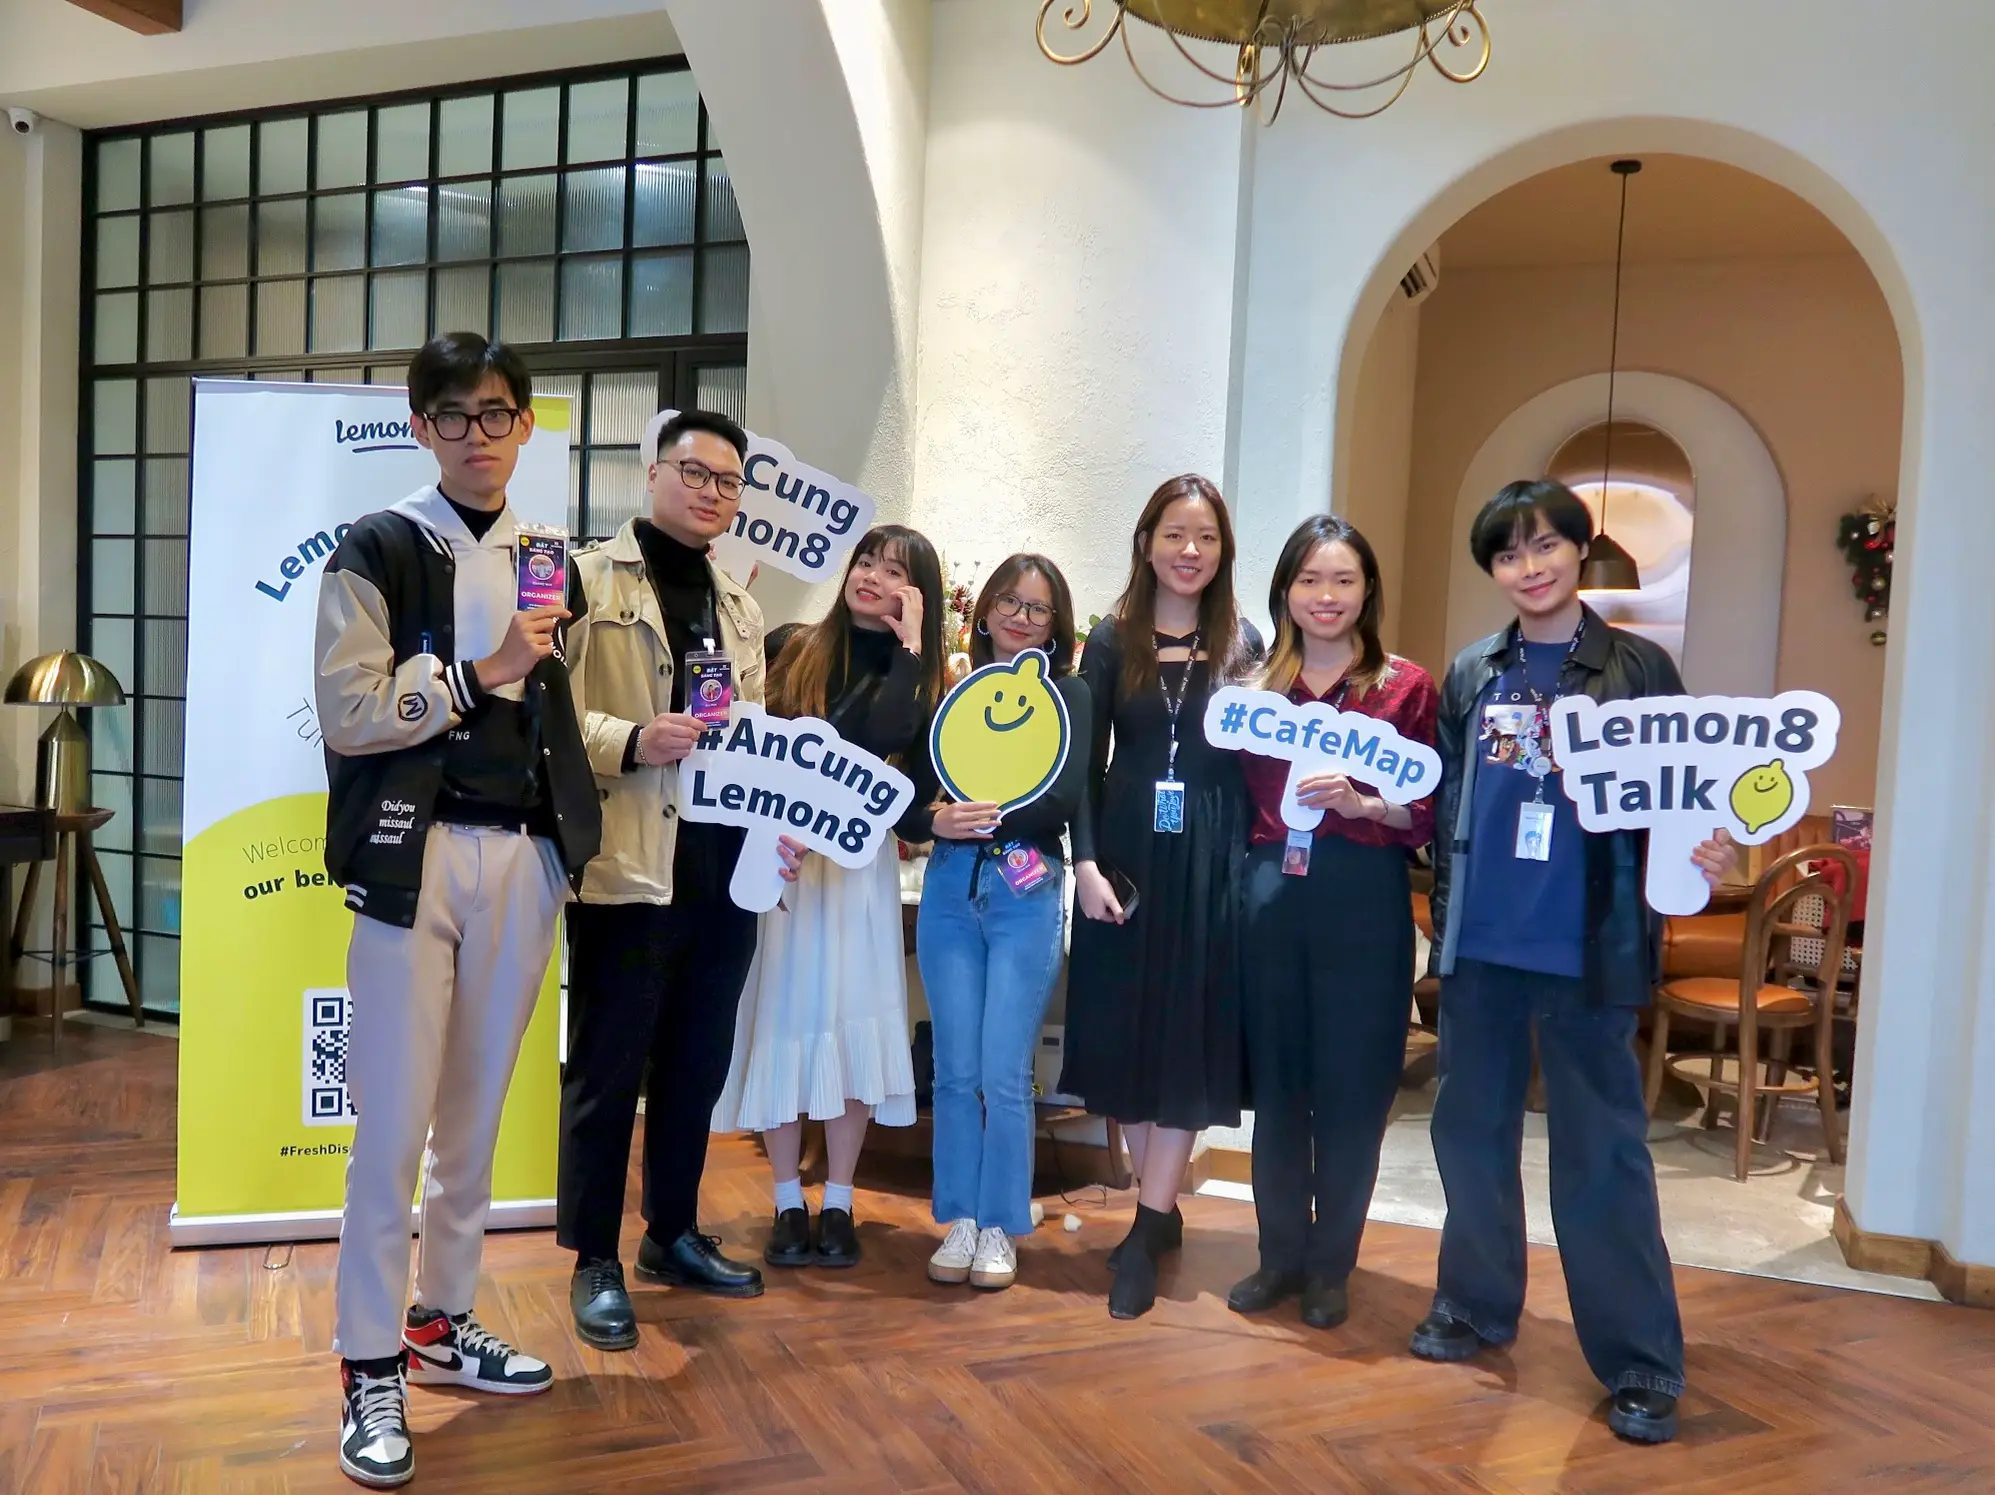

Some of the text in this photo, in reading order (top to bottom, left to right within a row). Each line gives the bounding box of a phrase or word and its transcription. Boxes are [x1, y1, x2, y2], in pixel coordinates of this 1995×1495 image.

[1219, 702, 1426, 788] #CafeMap
[1565, 707, 1819, 753] Lemon8
[696, 717, 900, 816] #AnCung
[1580, 765, 1719, 815] Talk
[692, 770, 872, 854] Lemon8
[243, 877, 285, 900] our
[280, 1143, 352, 1157] #FreshDis
